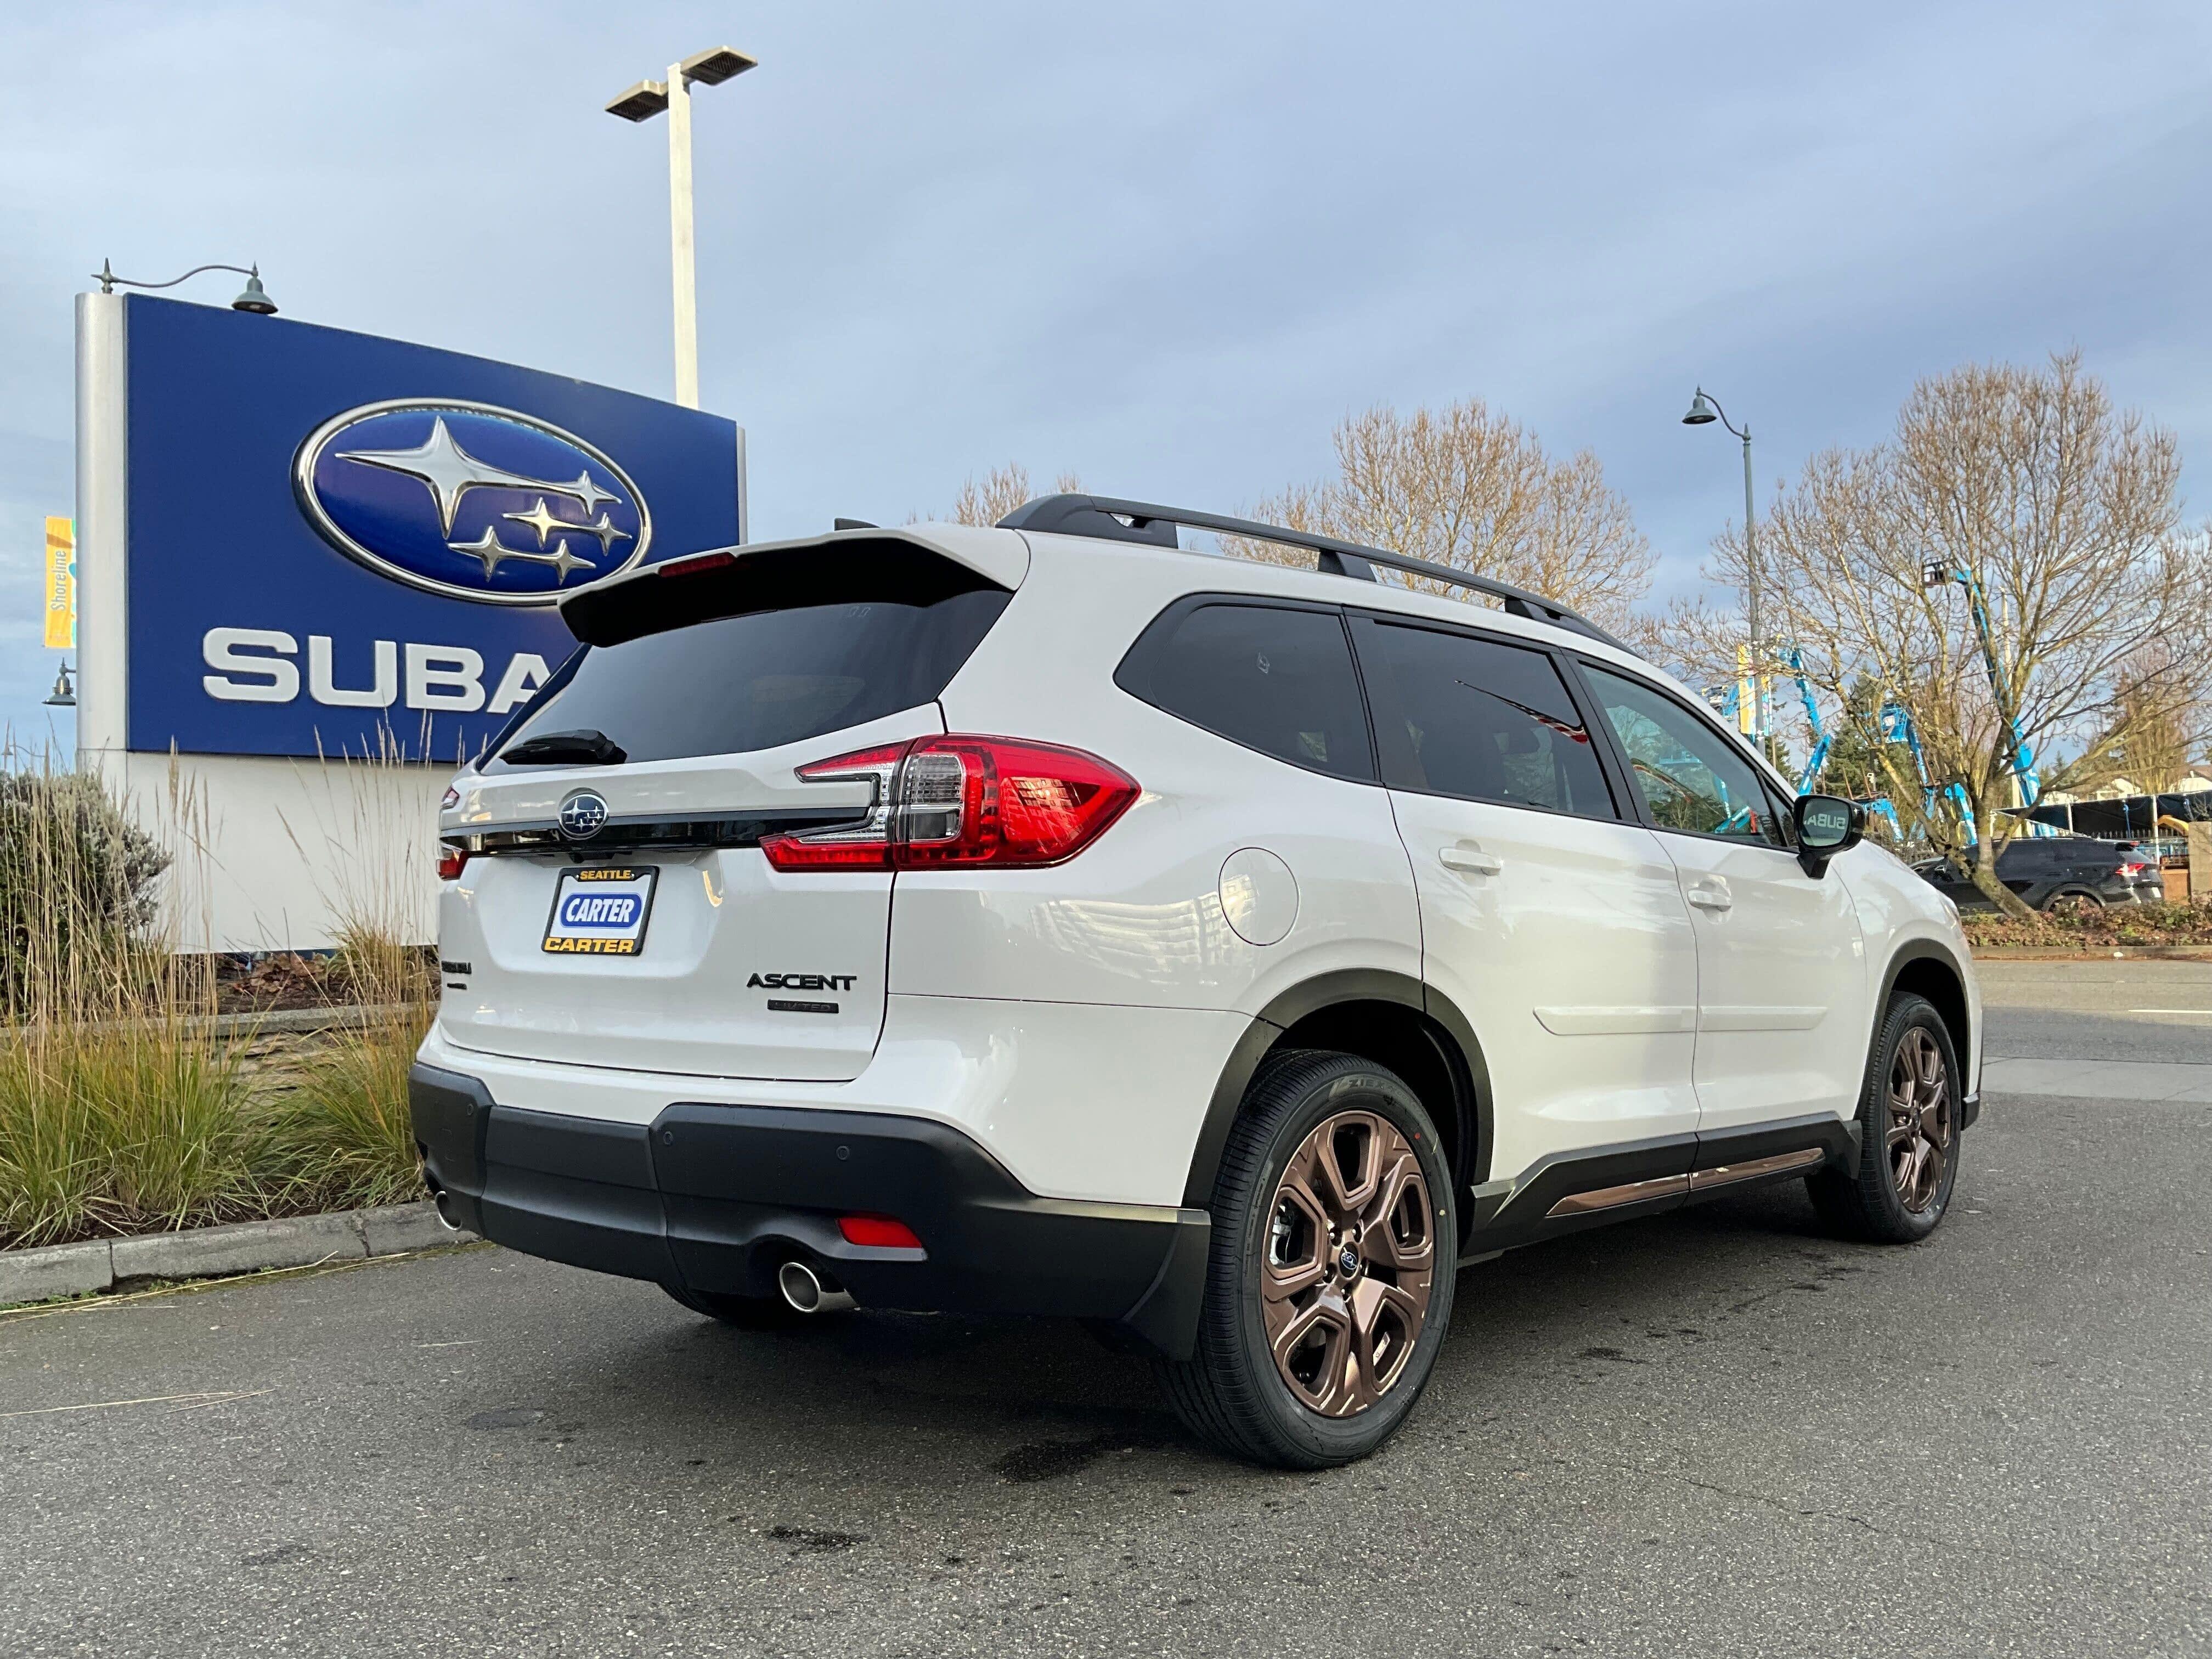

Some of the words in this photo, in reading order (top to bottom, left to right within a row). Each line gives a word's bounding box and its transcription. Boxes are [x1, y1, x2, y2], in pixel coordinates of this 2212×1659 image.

[51, 550, 66, 611] Shoreline
[580, 870, 631, 881] SEATTLE
[566, 898, 635, 922] CARTER
[544, 936, 635, 953] CARTER
[747, 973, 857, 990] ASCENT
